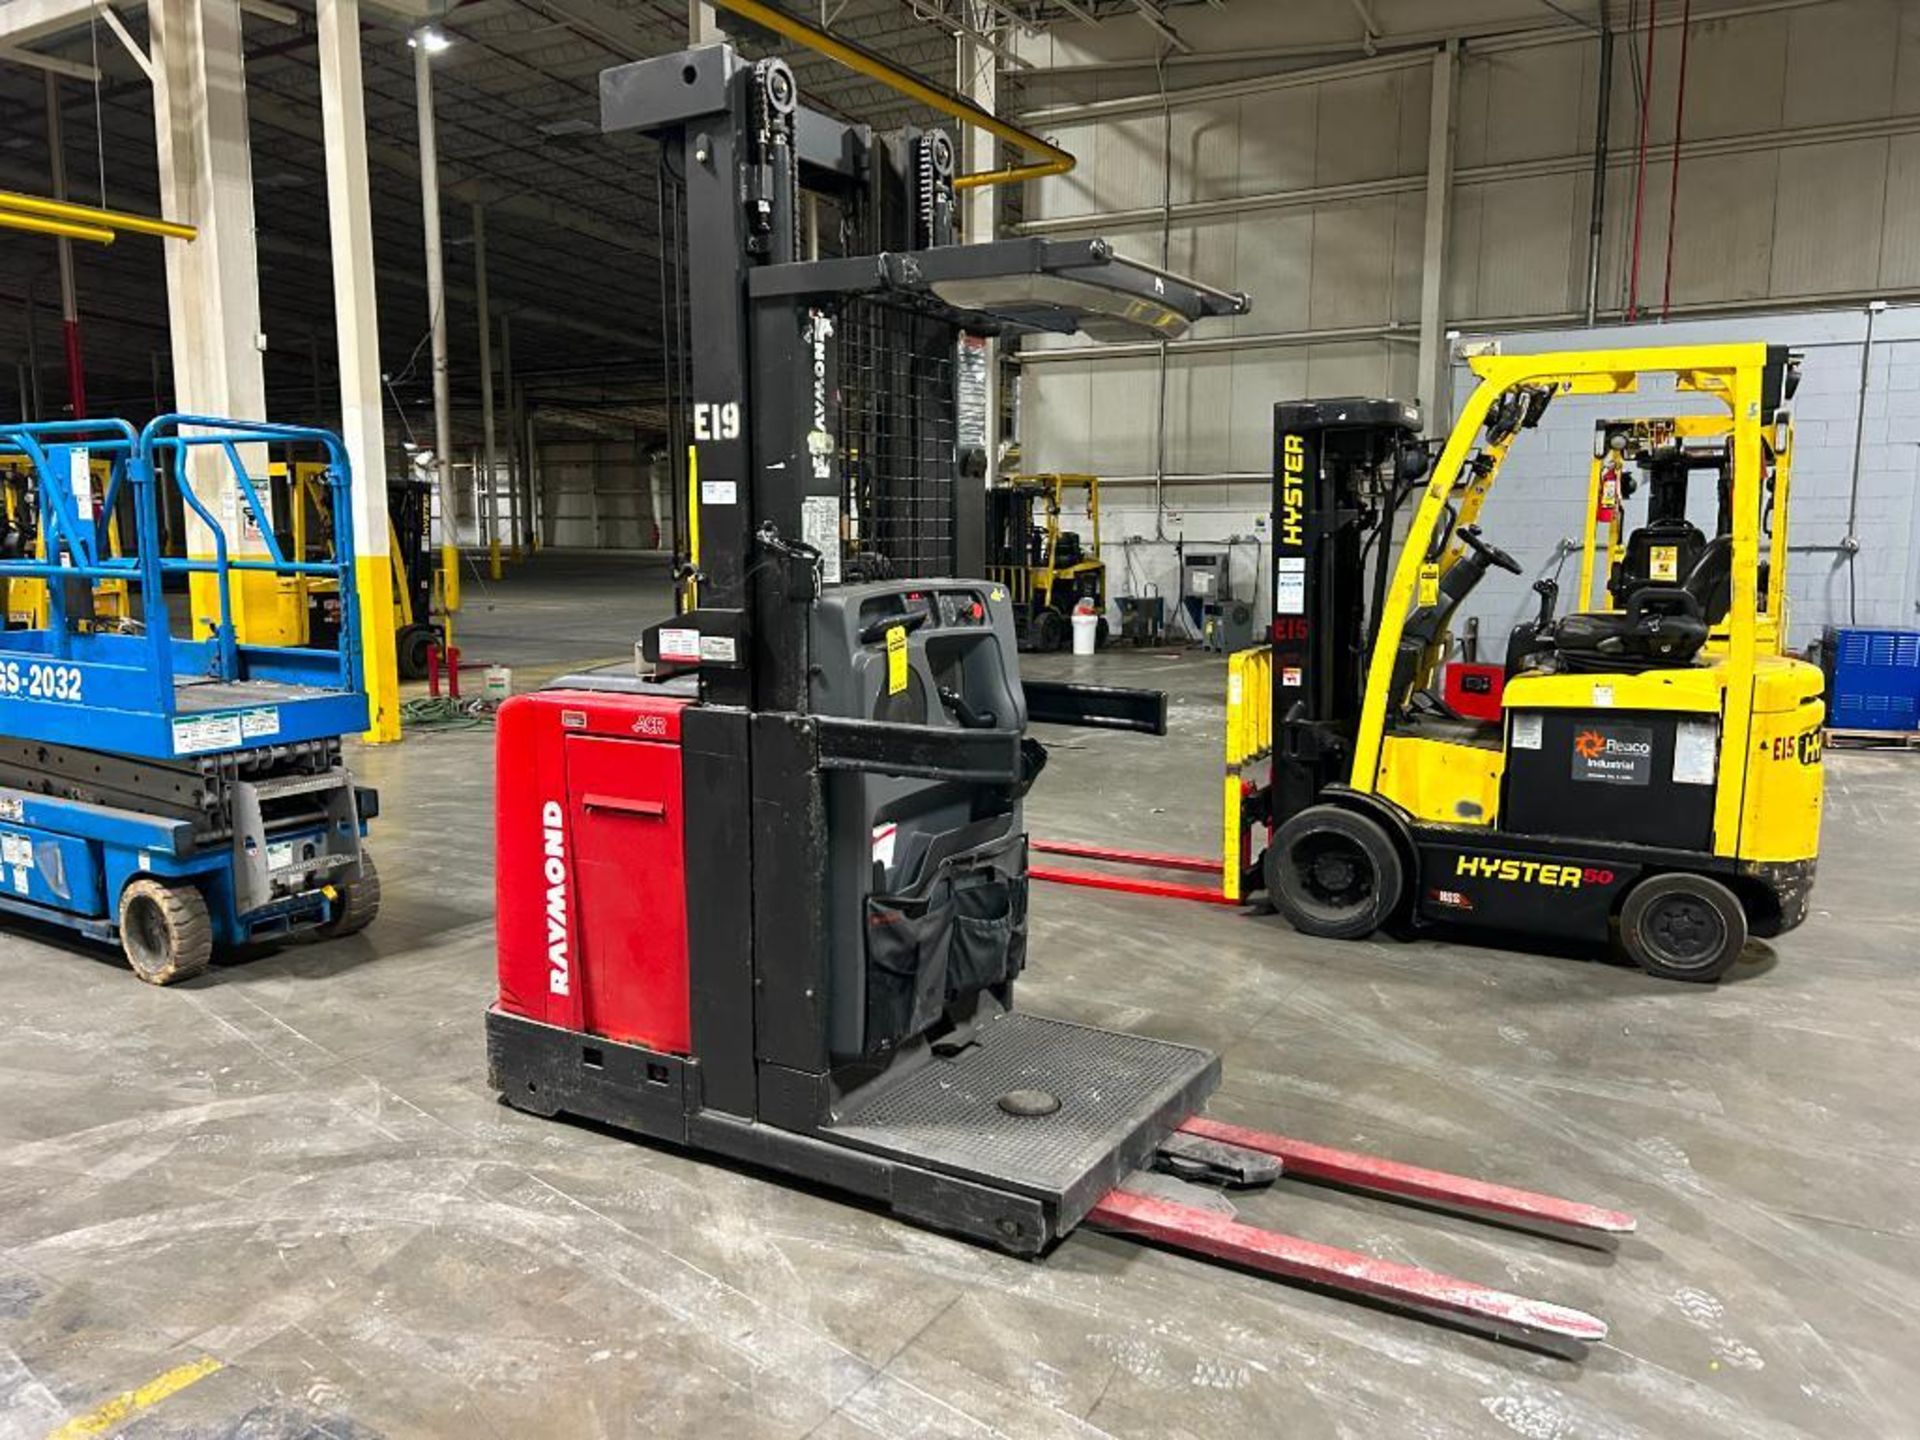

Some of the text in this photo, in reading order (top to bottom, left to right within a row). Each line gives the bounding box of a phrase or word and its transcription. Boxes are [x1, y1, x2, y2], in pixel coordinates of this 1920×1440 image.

[693, 402, 741, 440] E19
[1282, 434, 1305, 546] HYSTER
[1587, 758, 1634, 771] Industrial
[1456, 855, 1615, 888] HYSTER 50
[542, 800, 570, 997] RAYMOND
